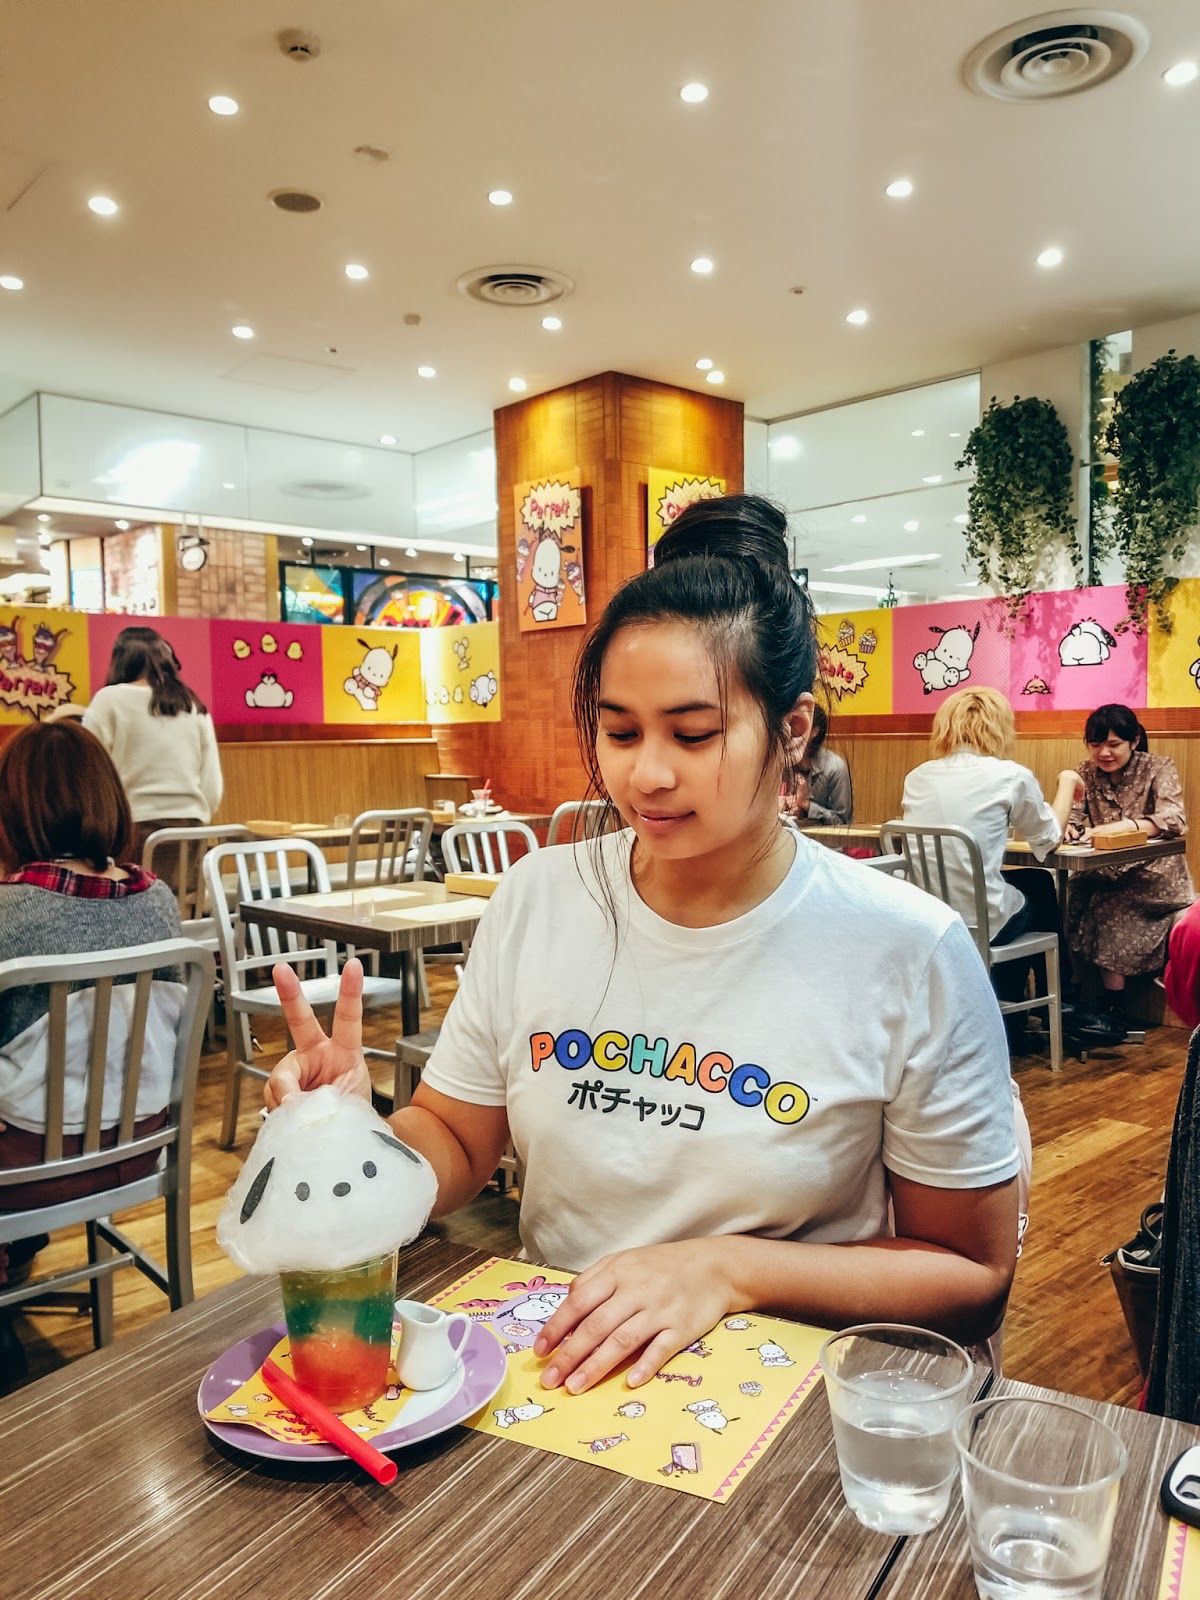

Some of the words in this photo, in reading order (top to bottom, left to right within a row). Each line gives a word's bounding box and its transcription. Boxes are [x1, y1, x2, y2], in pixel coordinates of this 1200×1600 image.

[530, 498, 570, 520] Parfait
[818, 655, 855, 684] Cake
[529, 1028, 810, 1125] POCHACCO
[567, 1079, 705, 1131] ポチャッコ
